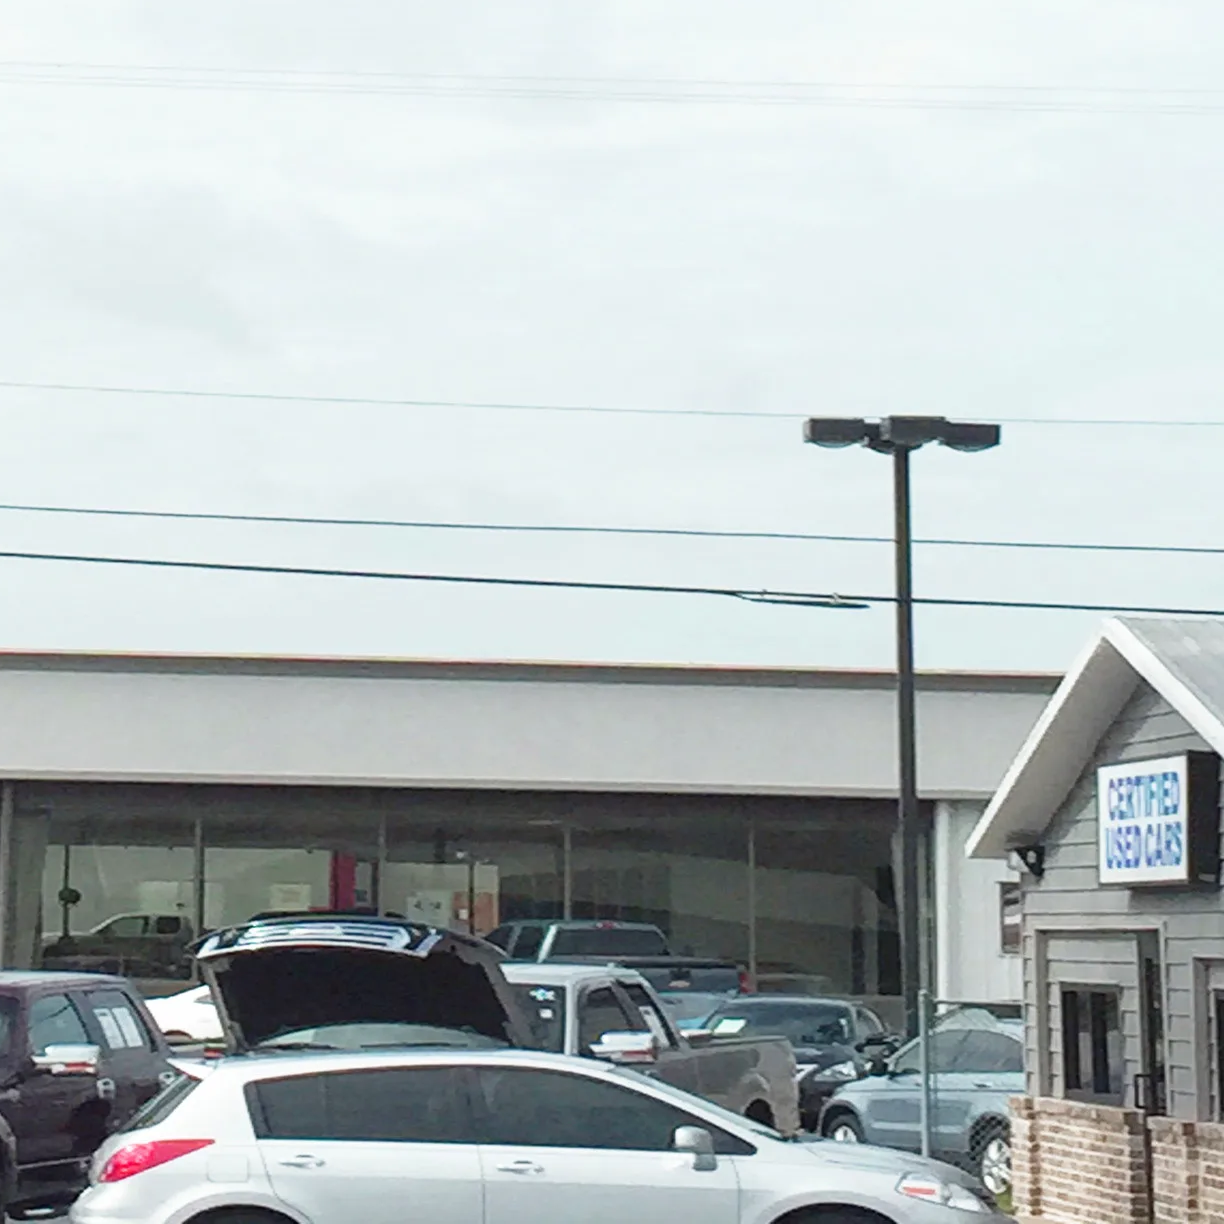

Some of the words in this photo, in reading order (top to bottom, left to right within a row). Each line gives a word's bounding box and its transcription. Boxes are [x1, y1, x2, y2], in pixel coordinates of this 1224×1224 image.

[1107, 771, 1180, 821] CERTIFIED
[1105, 824, 1142, 870] USED
[1144, 821, 1183, 867] CARS
